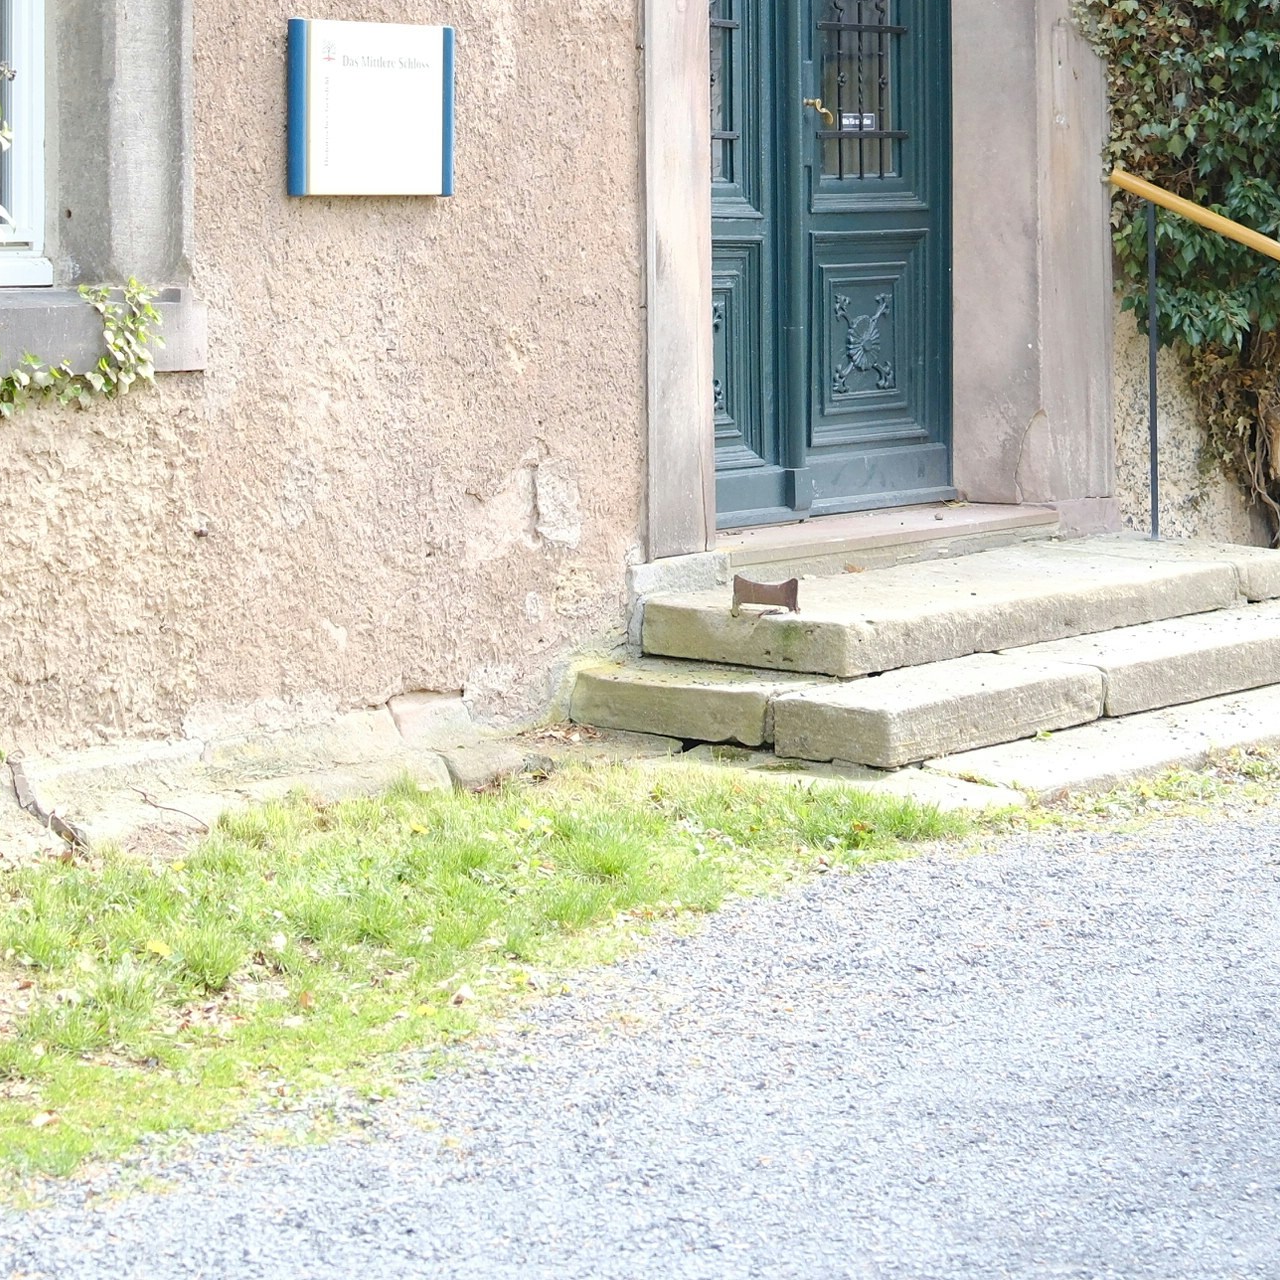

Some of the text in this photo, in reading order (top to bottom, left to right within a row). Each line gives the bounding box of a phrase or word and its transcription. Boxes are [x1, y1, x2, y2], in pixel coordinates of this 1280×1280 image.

[342, 55, 431, 70] Das Mittlere Schloss
